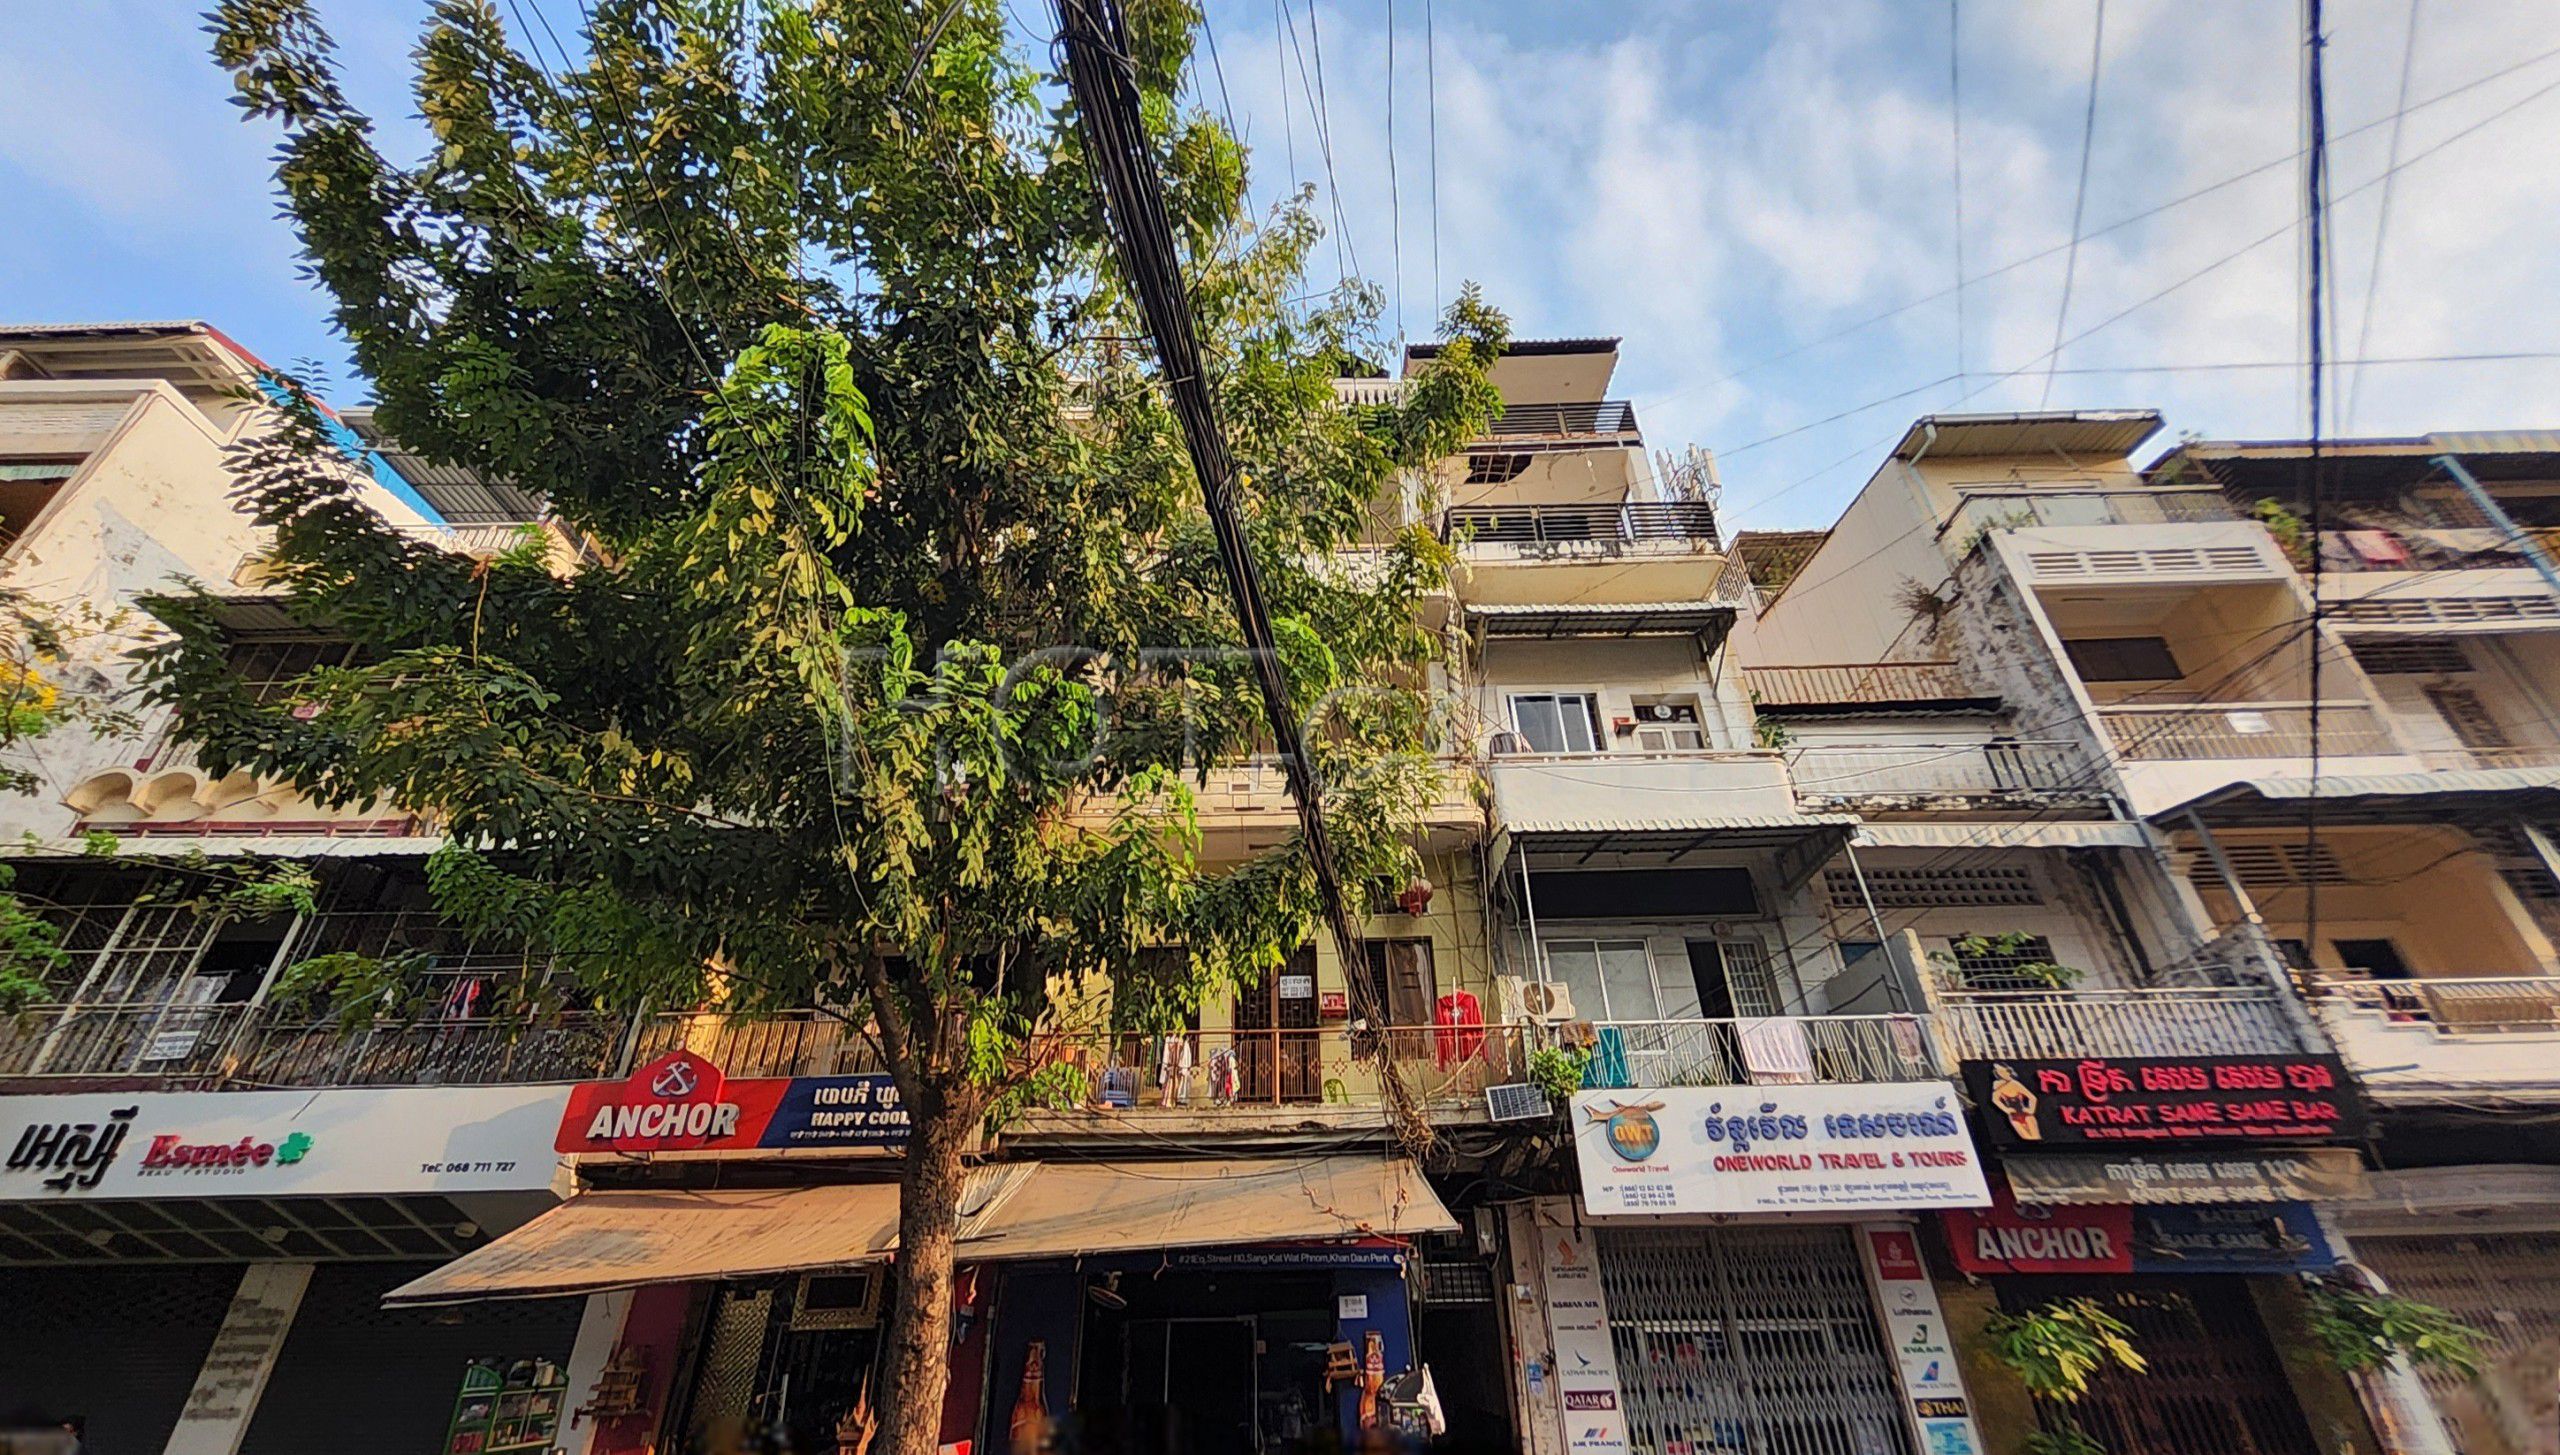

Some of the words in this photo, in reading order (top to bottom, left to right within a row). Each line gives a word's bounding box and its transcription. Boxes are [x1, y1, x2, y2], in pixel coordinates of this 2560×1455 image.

[586, 1103, 739, 1139] ANCHOR
[811, 1112, 866, 1126] HAPPY
[869, 1110, 911, 1125] COOL
[2060, 1106, 2151, 1125] KATRAT
[2156, 1103, 2223, 1123] SAME
[2226, 1101, 2294, 1121] SAME
[2290, 1100, 2340, 1121] BAR
[1614, 1124, 1653, 1143] OWT
[140, 1135, 275, 1168] Esmée
[446, 1162, 470, 1173] 068
[473, 1162, 492, 1173] 711
[495, 1162, 516, 1172] 727
[1648, 1164, 1669, 1172] Travel
[1713, 1155, 1811, 1173] ONEWORLD
[1818, 1153, 1886, 1171] TRAVEL
[1892, 1153, 1905, 1167] &
[1908, 1151, 1968, 1167] TOURS
[1978, 1226, 2117, 1261] ANCHOR
[1566, 1393, 1599, 1407] QATAR
